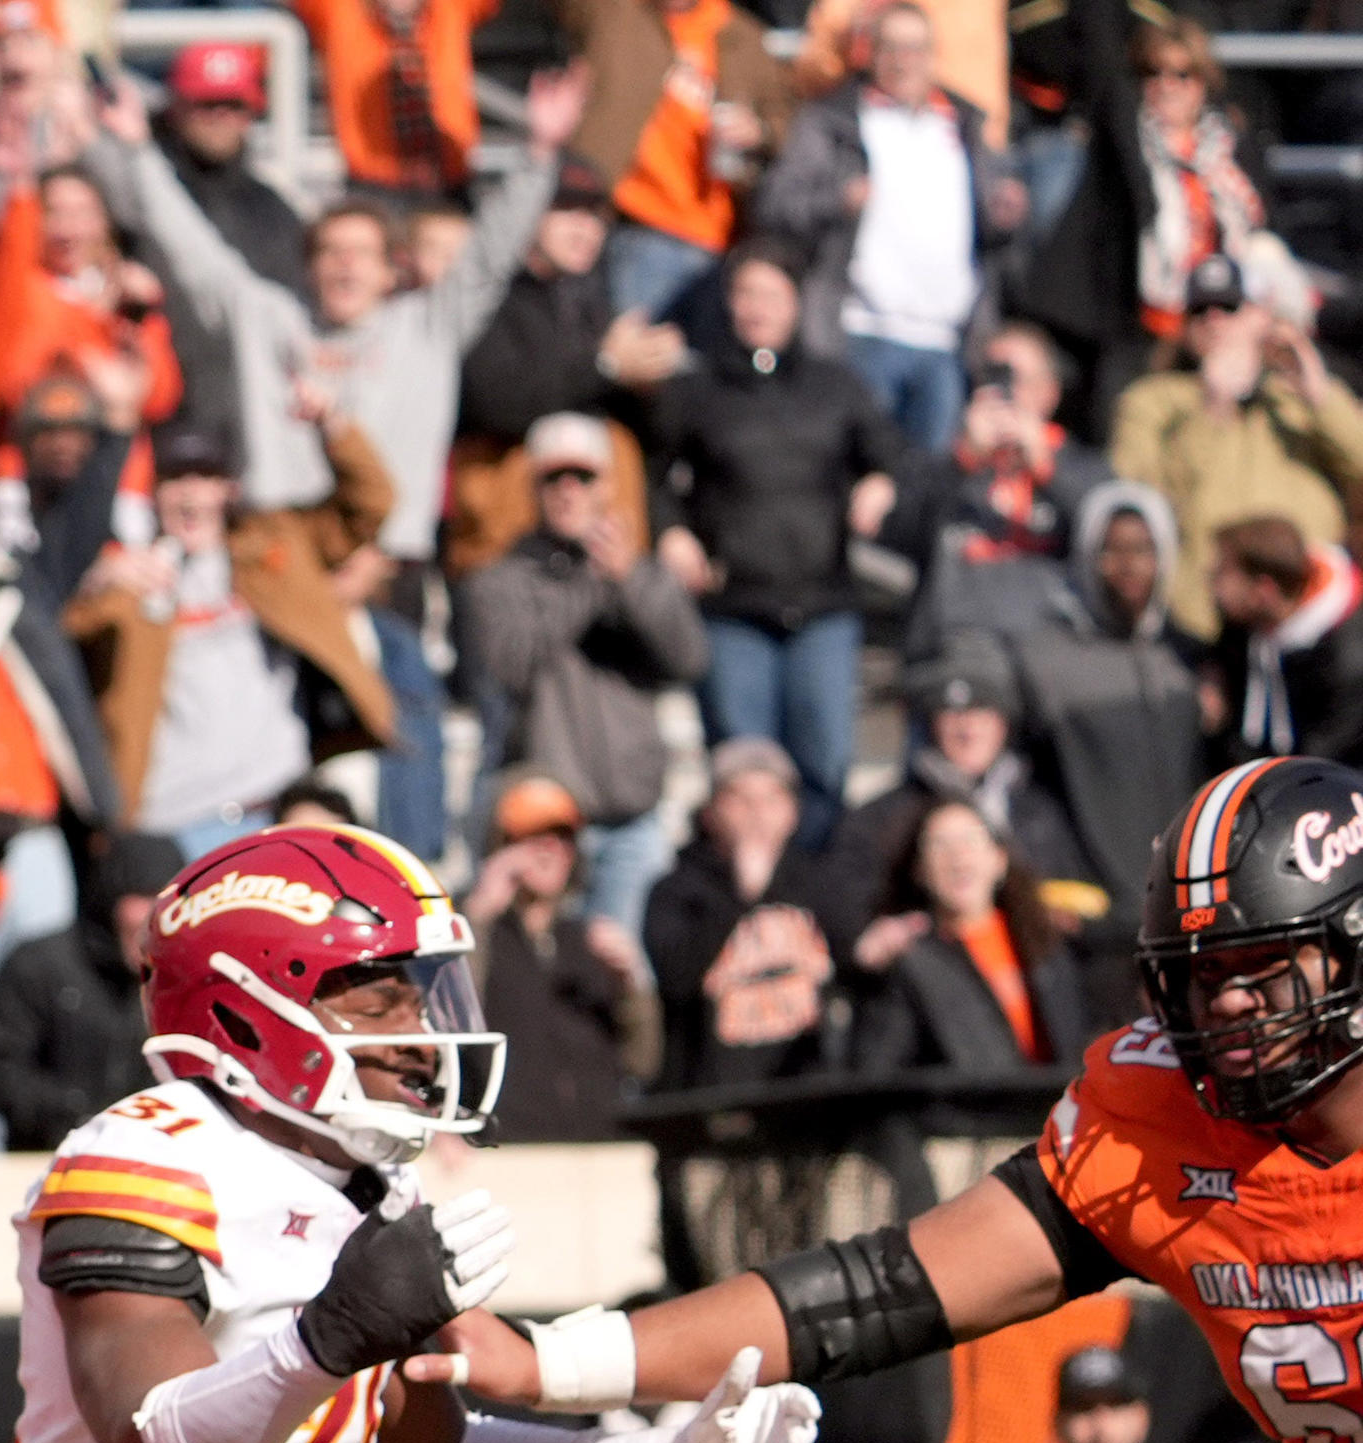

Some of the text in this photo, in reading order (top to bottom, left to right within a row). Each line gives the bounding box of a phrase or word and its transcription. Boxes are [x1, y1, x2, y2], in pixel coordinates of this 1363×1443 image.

[1293, 791, 1363, 883] Cow
[159, 870, 335, 936] Cyclones
[1178, 1164, 1238, 1204] XII
